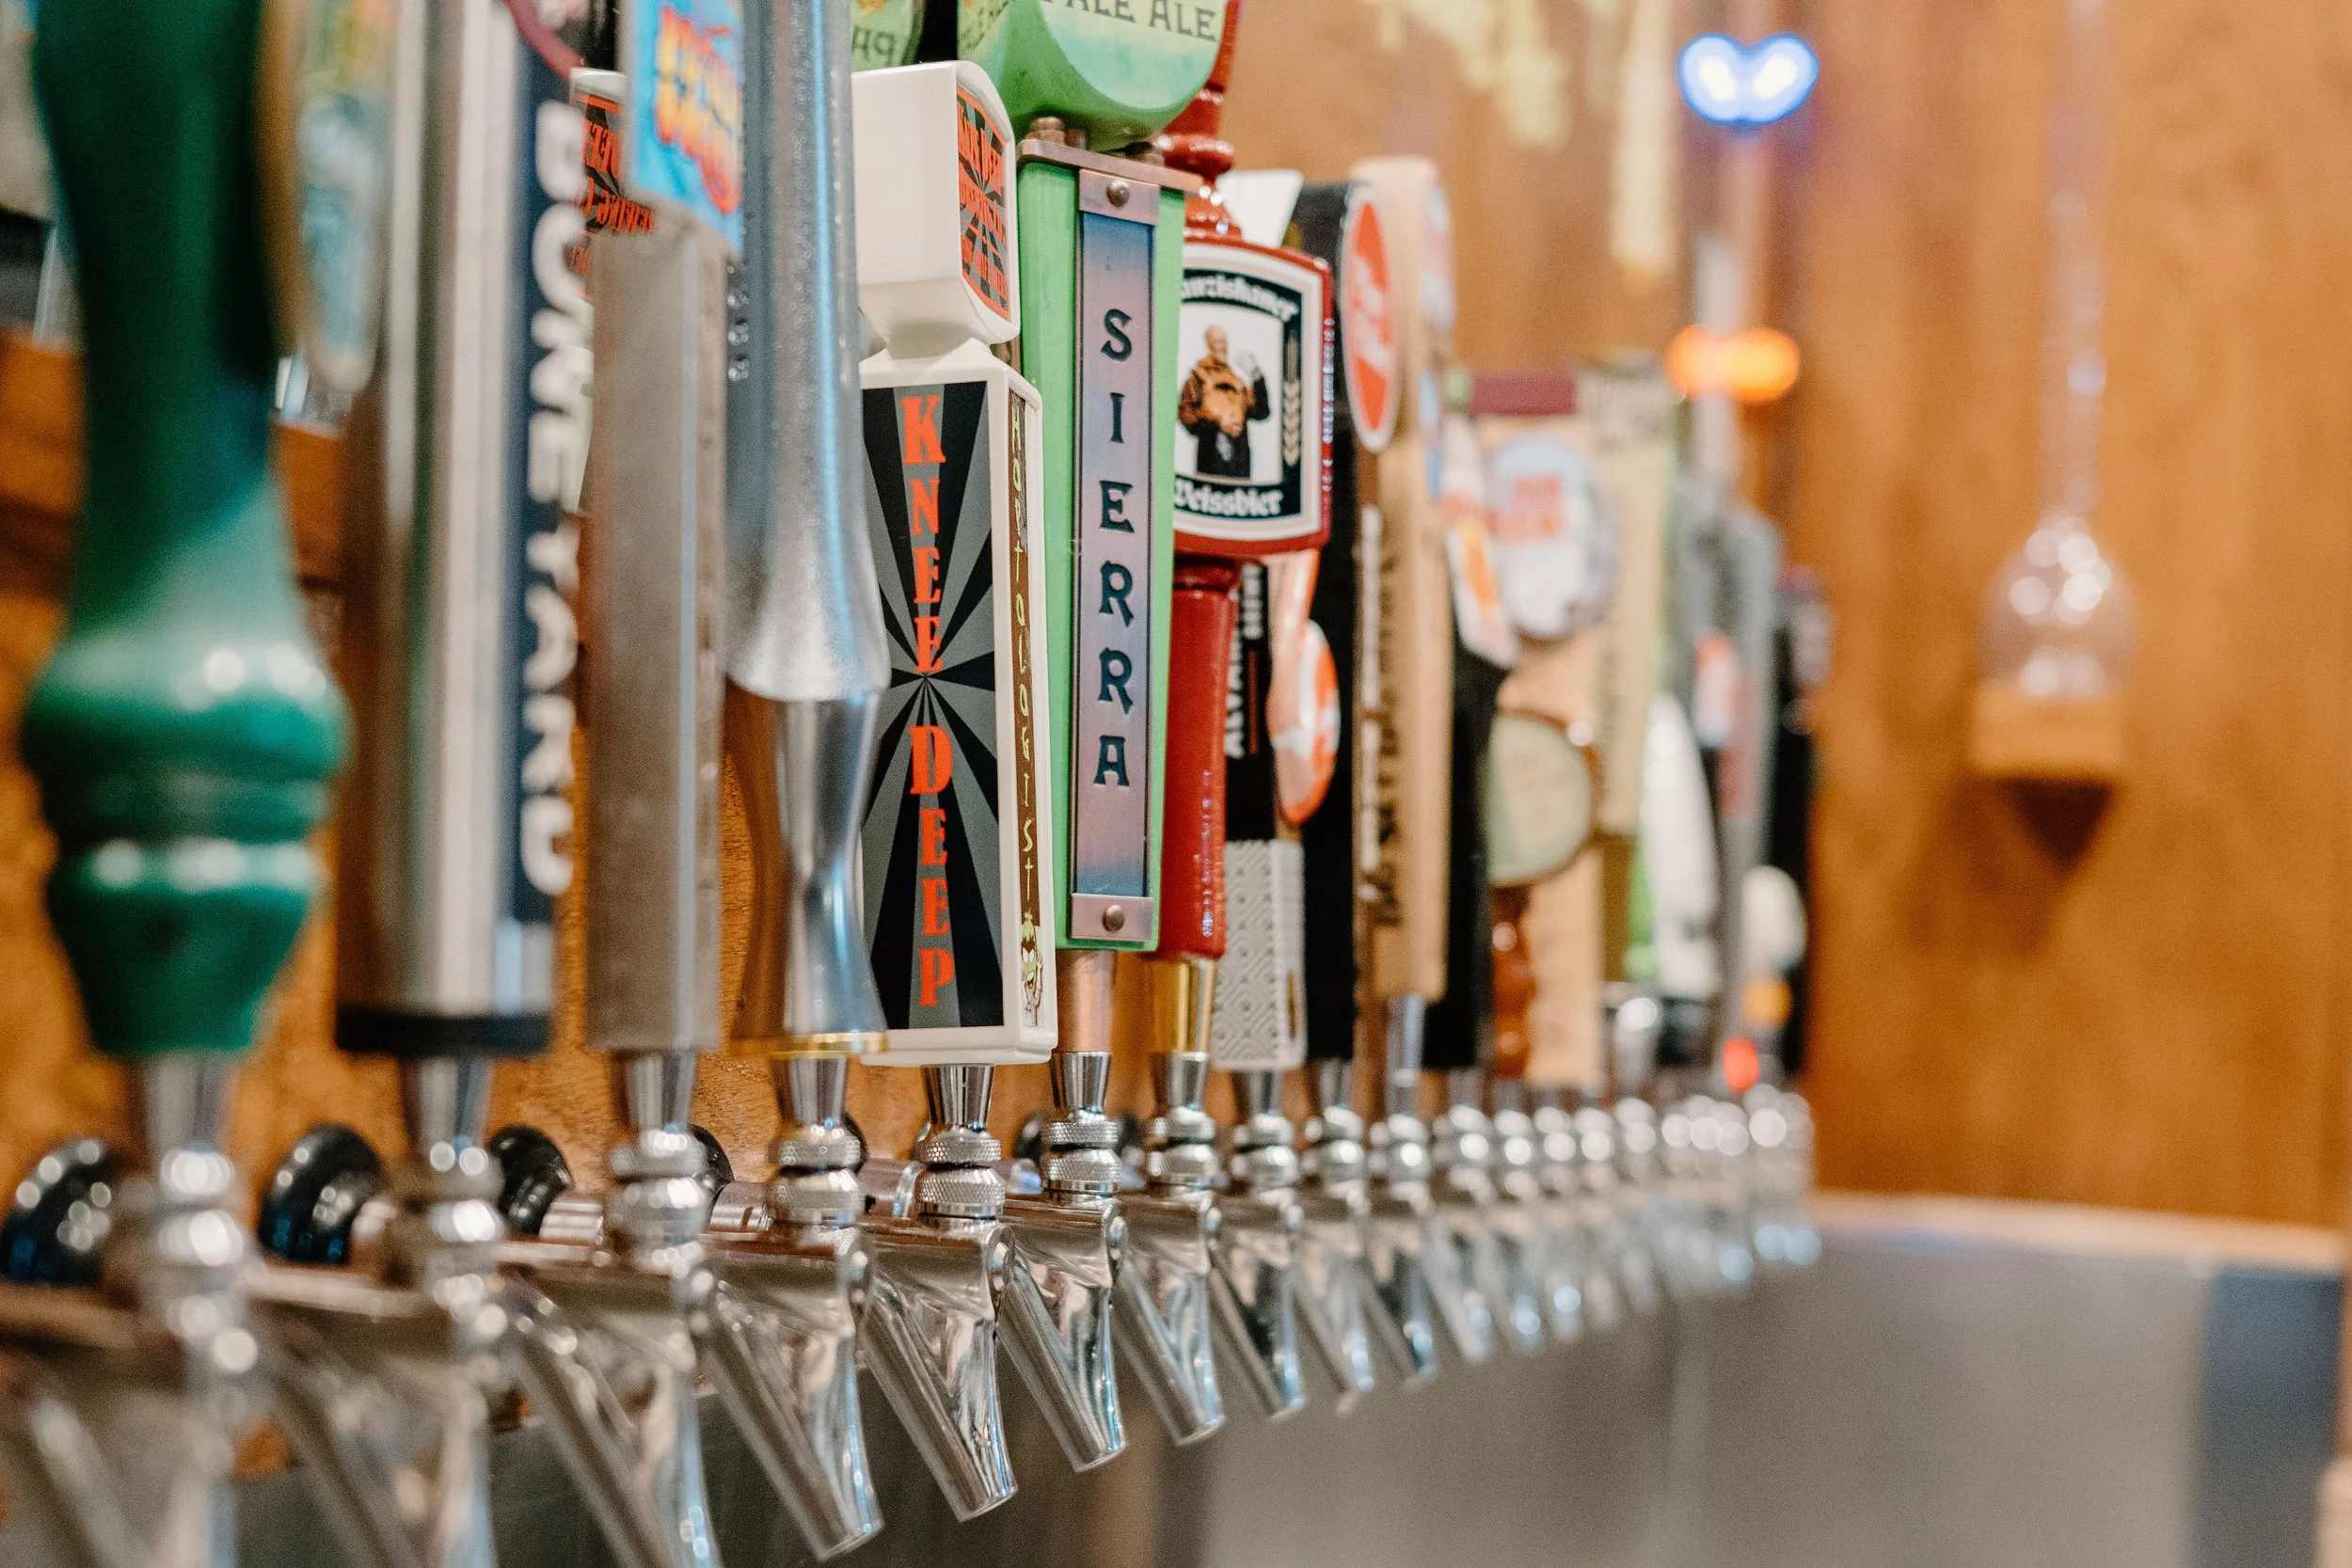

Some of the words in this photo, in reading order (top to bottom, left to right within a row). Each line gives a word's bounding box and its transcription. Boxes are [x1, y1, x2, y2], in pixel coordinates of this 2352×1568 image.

[1150, 0, 1216, 41] ALE
[518, 100, 581, 895] BONEYARD
[901, 395, 946, 673] KNEE
[1093, 308, 1135, 787] SIERRA
[909, 724, 955, 1007] DEEP
